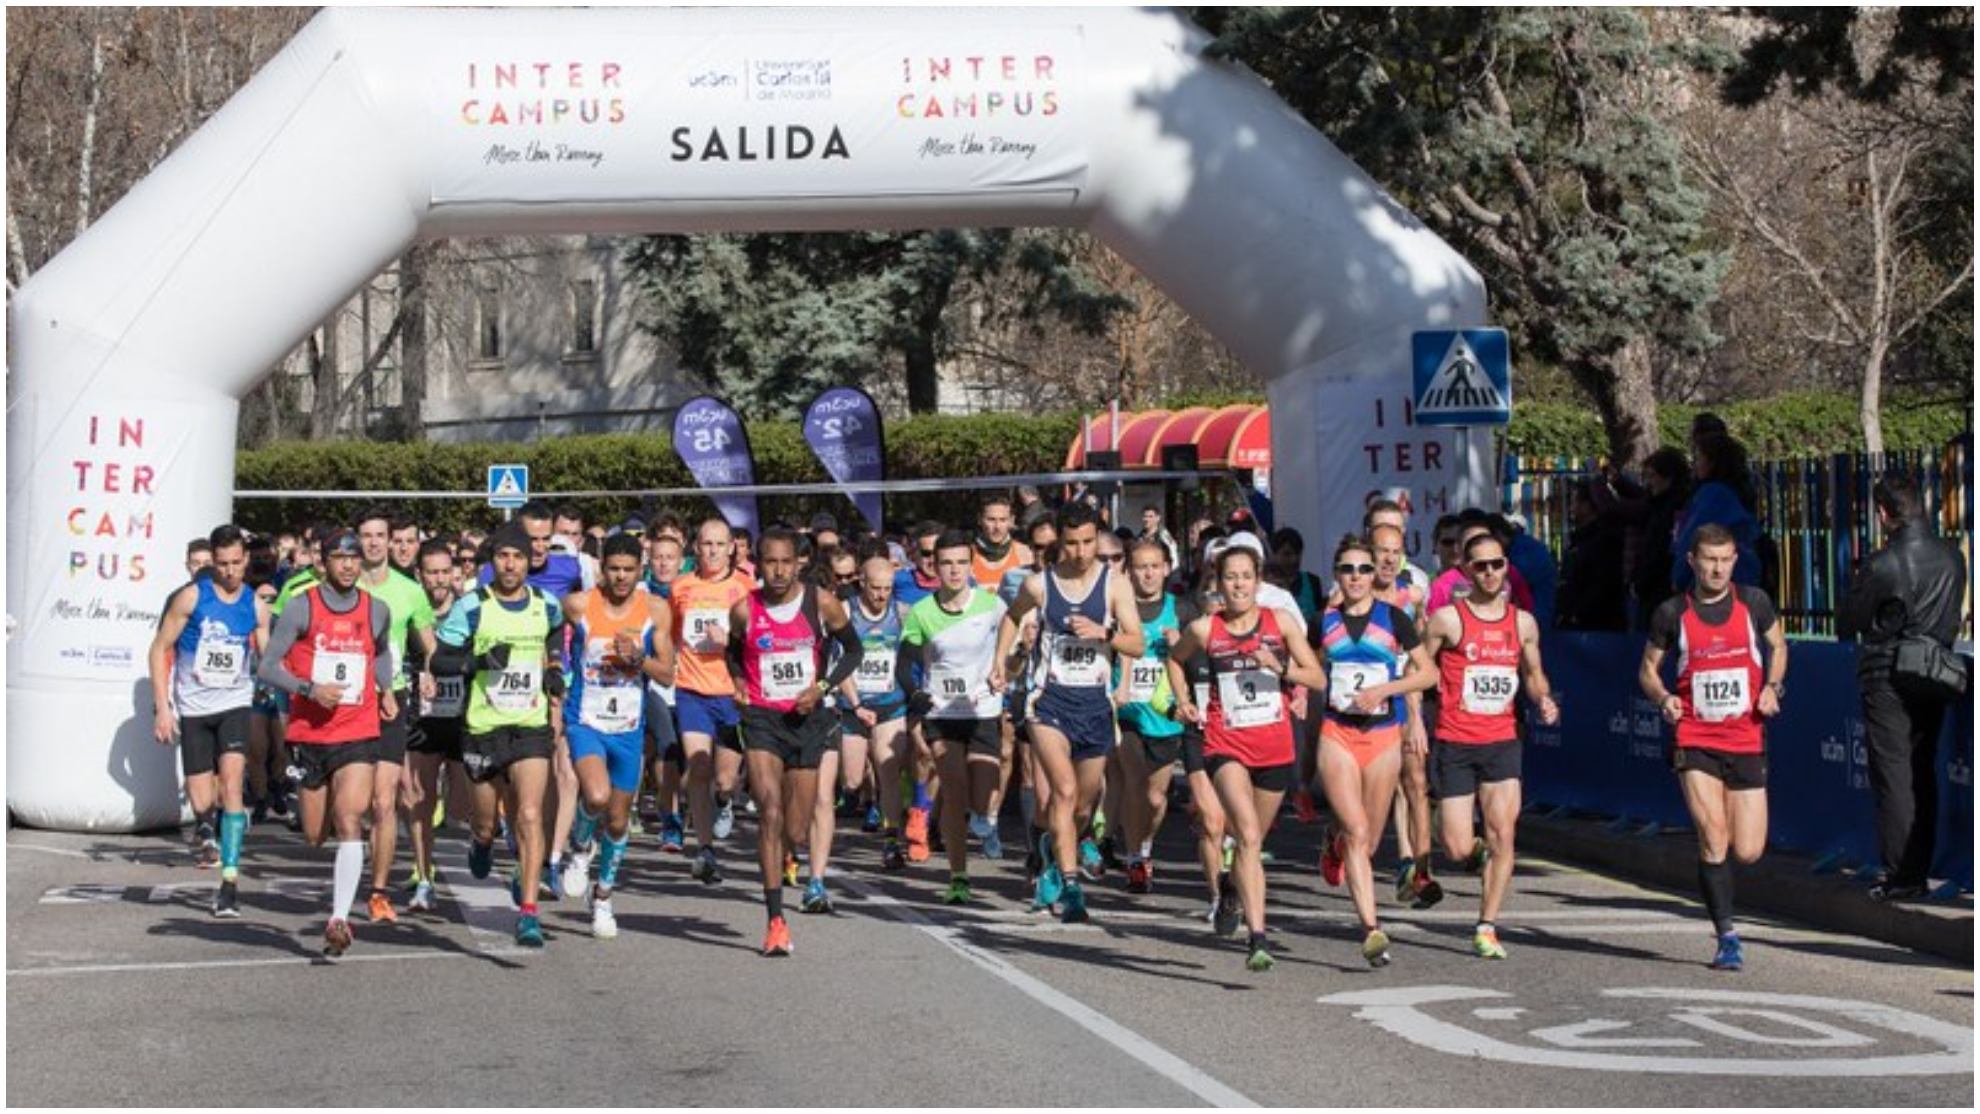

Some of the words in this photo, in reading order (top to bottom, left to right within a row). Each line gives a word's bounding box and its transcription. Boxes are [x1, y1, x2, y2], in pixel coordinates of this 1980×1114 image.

[468, 62, 622, 88] INTER
[903, 55, 1054, 82] INTER
[462, 99, 625, 125] CAMPUS
[897, 91, 1059, 118] CAMPUS
[670, 124, 851, 162] SALIDA
[1363, 441, 1443, 474] TER
[72, 459, 155, 496] TER
[67, 506, 154, 540] CAM
[69, 551, 146, 583] PUS
[206, 651, 234, 668] 765
[335, 662, 347, 681] 8
[772, 661, 804, 681] 581
[501, 671, 531, 691] 764
[1244, 681, 1257, 702] 3
[1353, 672, 1365, 691] 2
[1702, 679, 1742, 702] 1124
[606, 696, 618, 716] 4
